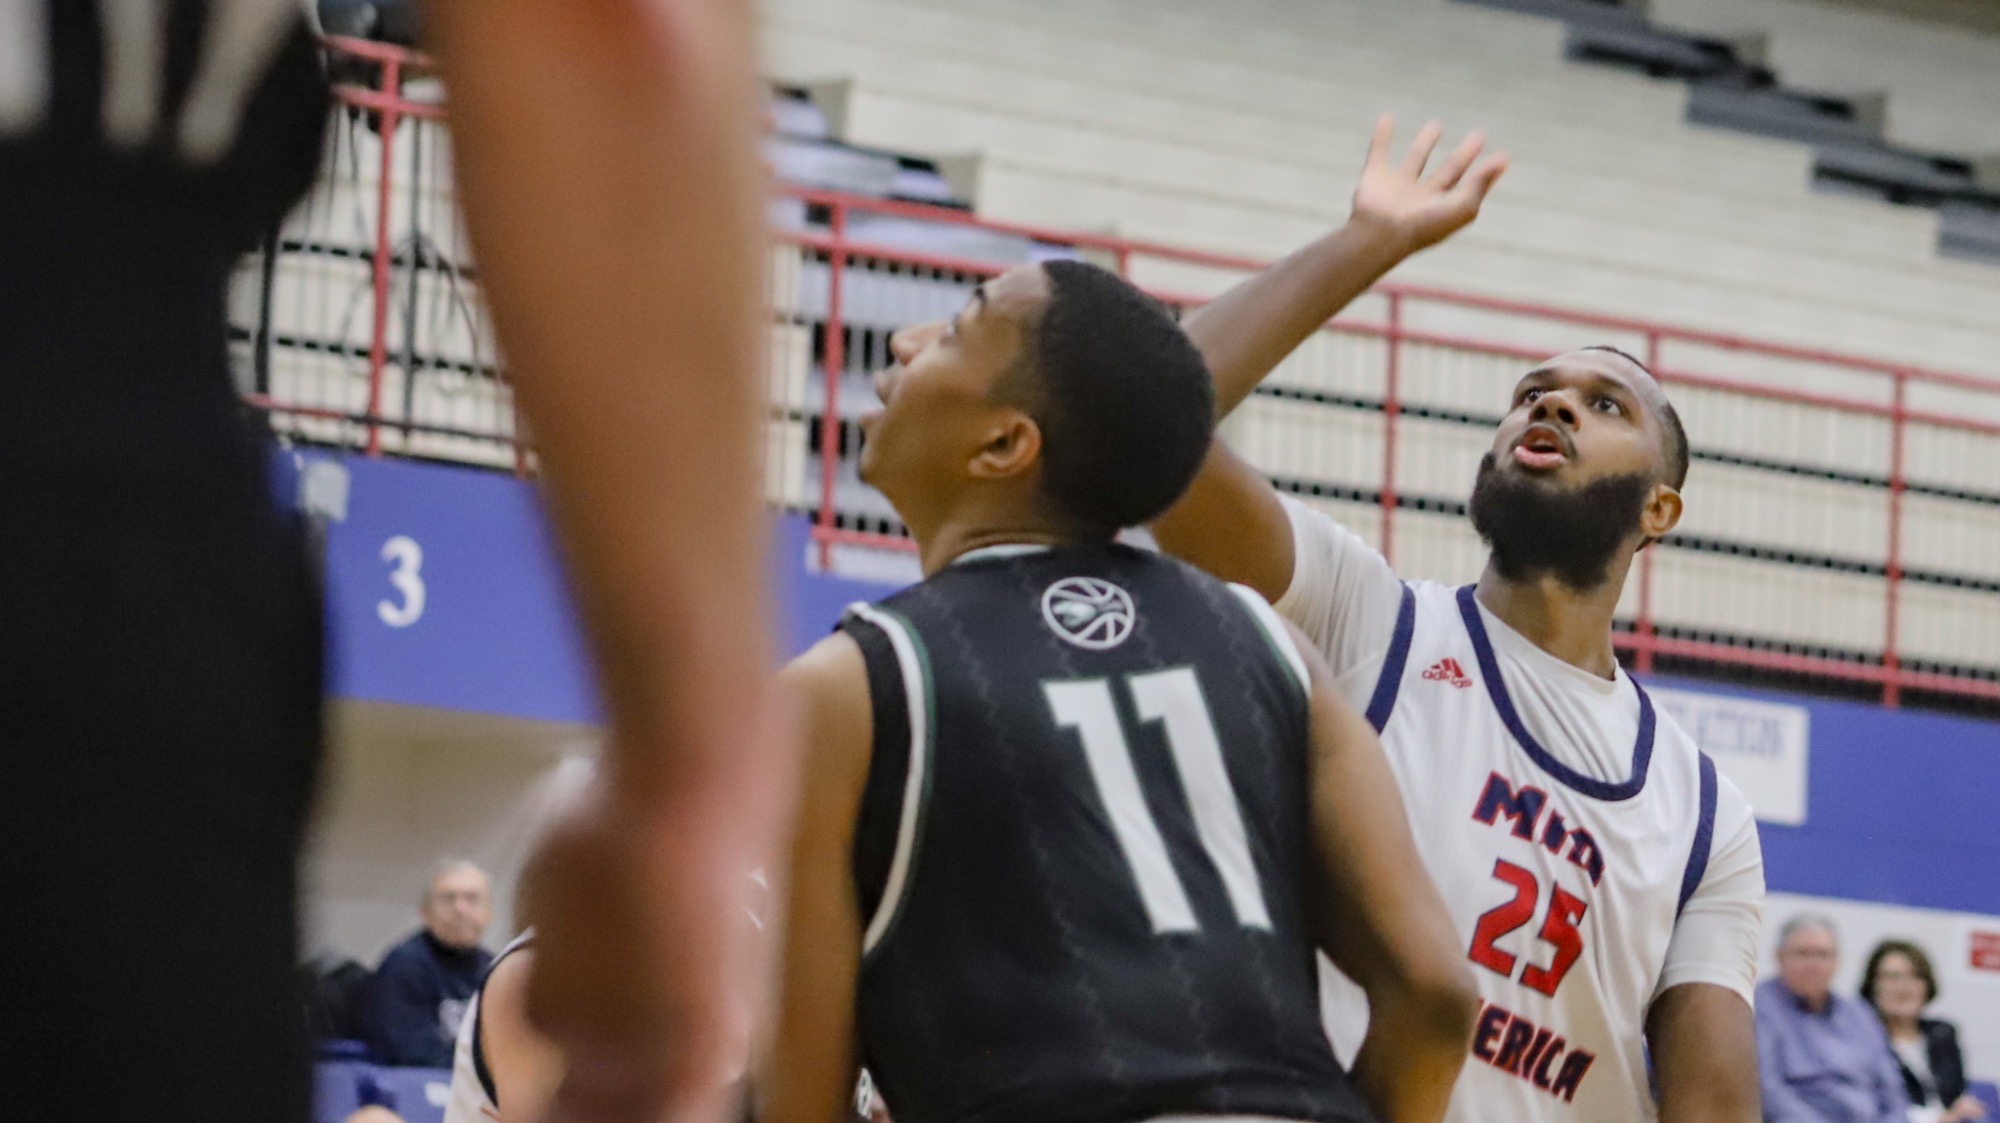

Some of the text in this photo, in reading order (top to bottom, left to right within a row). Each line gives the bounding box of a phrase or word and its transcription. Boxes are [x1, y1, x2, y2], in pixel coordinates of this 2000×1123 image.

[377, 535, 426, 628] 3
[1042, 666, 1272, 934] 11
[1468, 857, 1588, 998] 25
[1473, 998, 1597, 1104] ERICA
